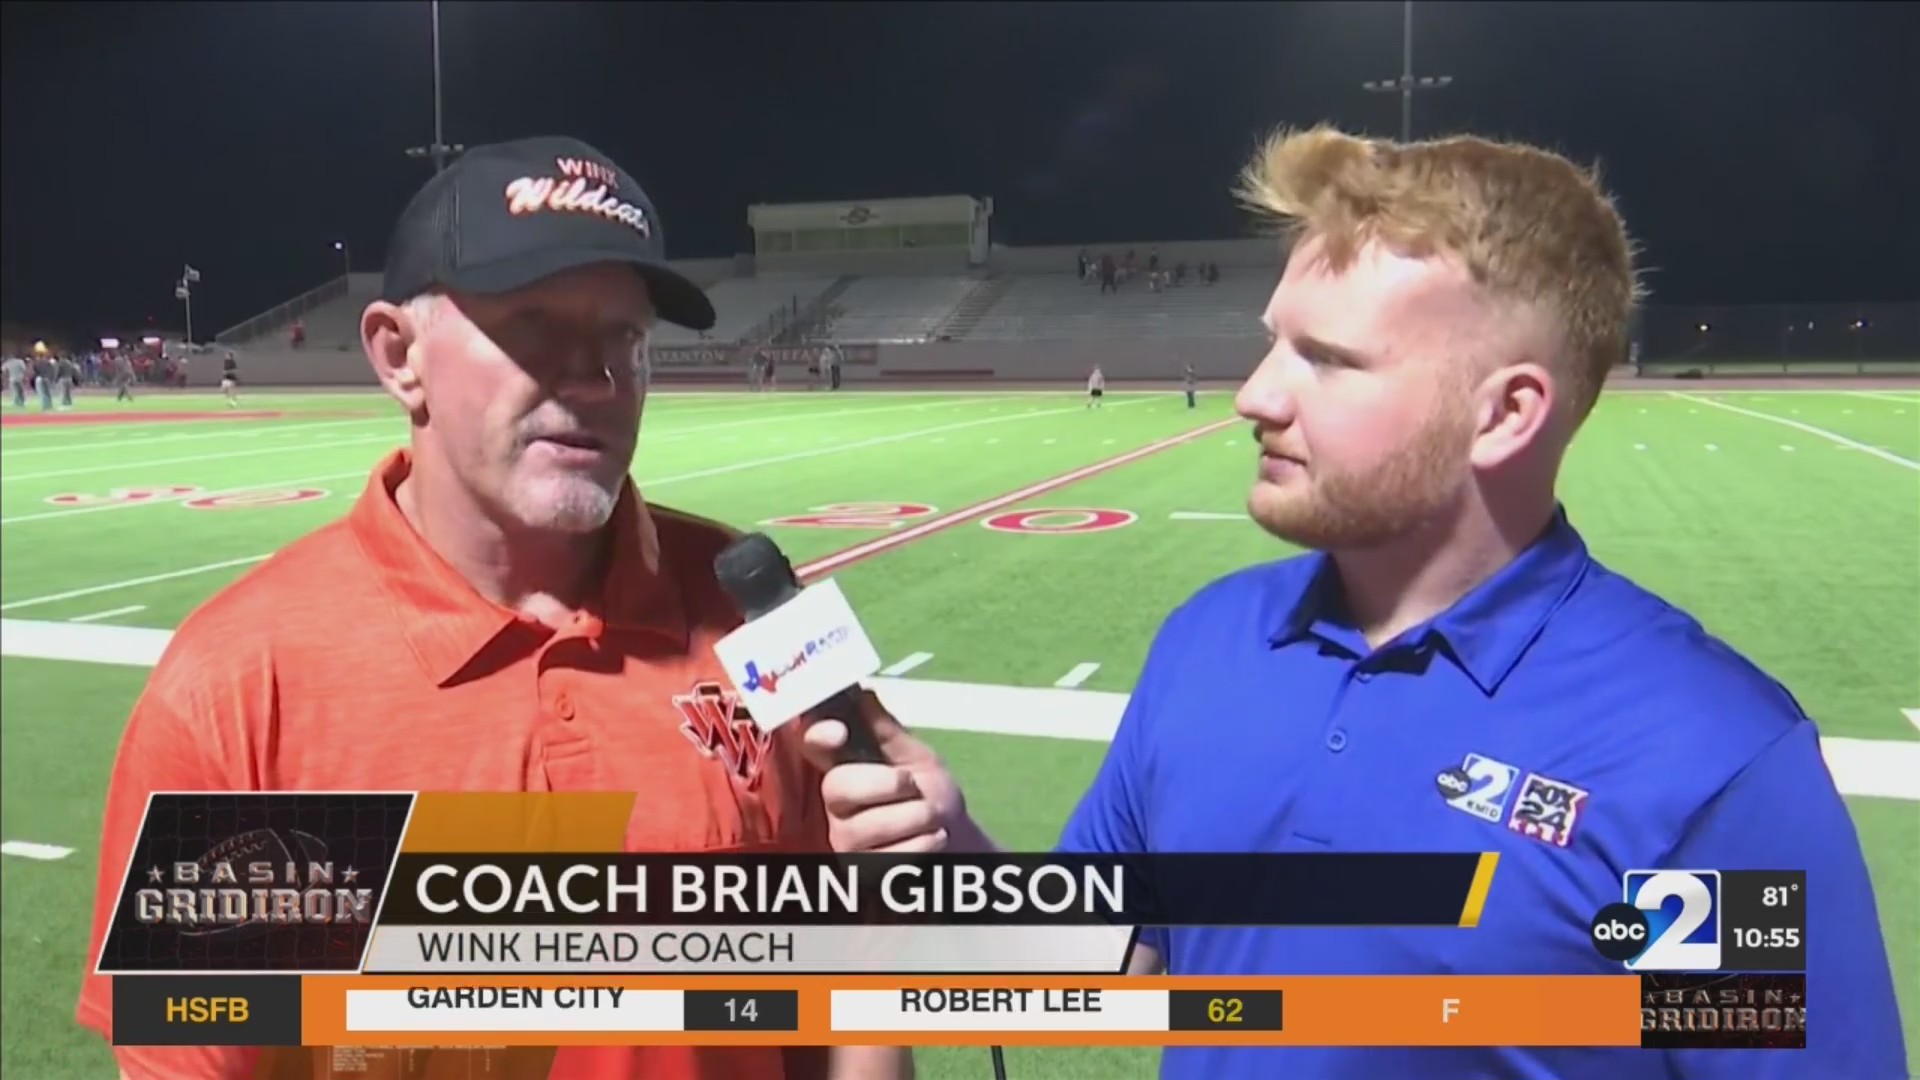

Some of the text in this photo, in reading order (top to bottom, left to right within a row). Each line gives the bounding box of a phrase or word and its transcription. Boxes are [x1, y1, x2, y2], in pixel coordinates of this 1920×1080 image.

[556, 157, 619, 189] WINK
[1466, 800, 1498, 819] KMID
[1524, 778, 1576, 812] FOX
[1515, 799, 1567, 832] 24
